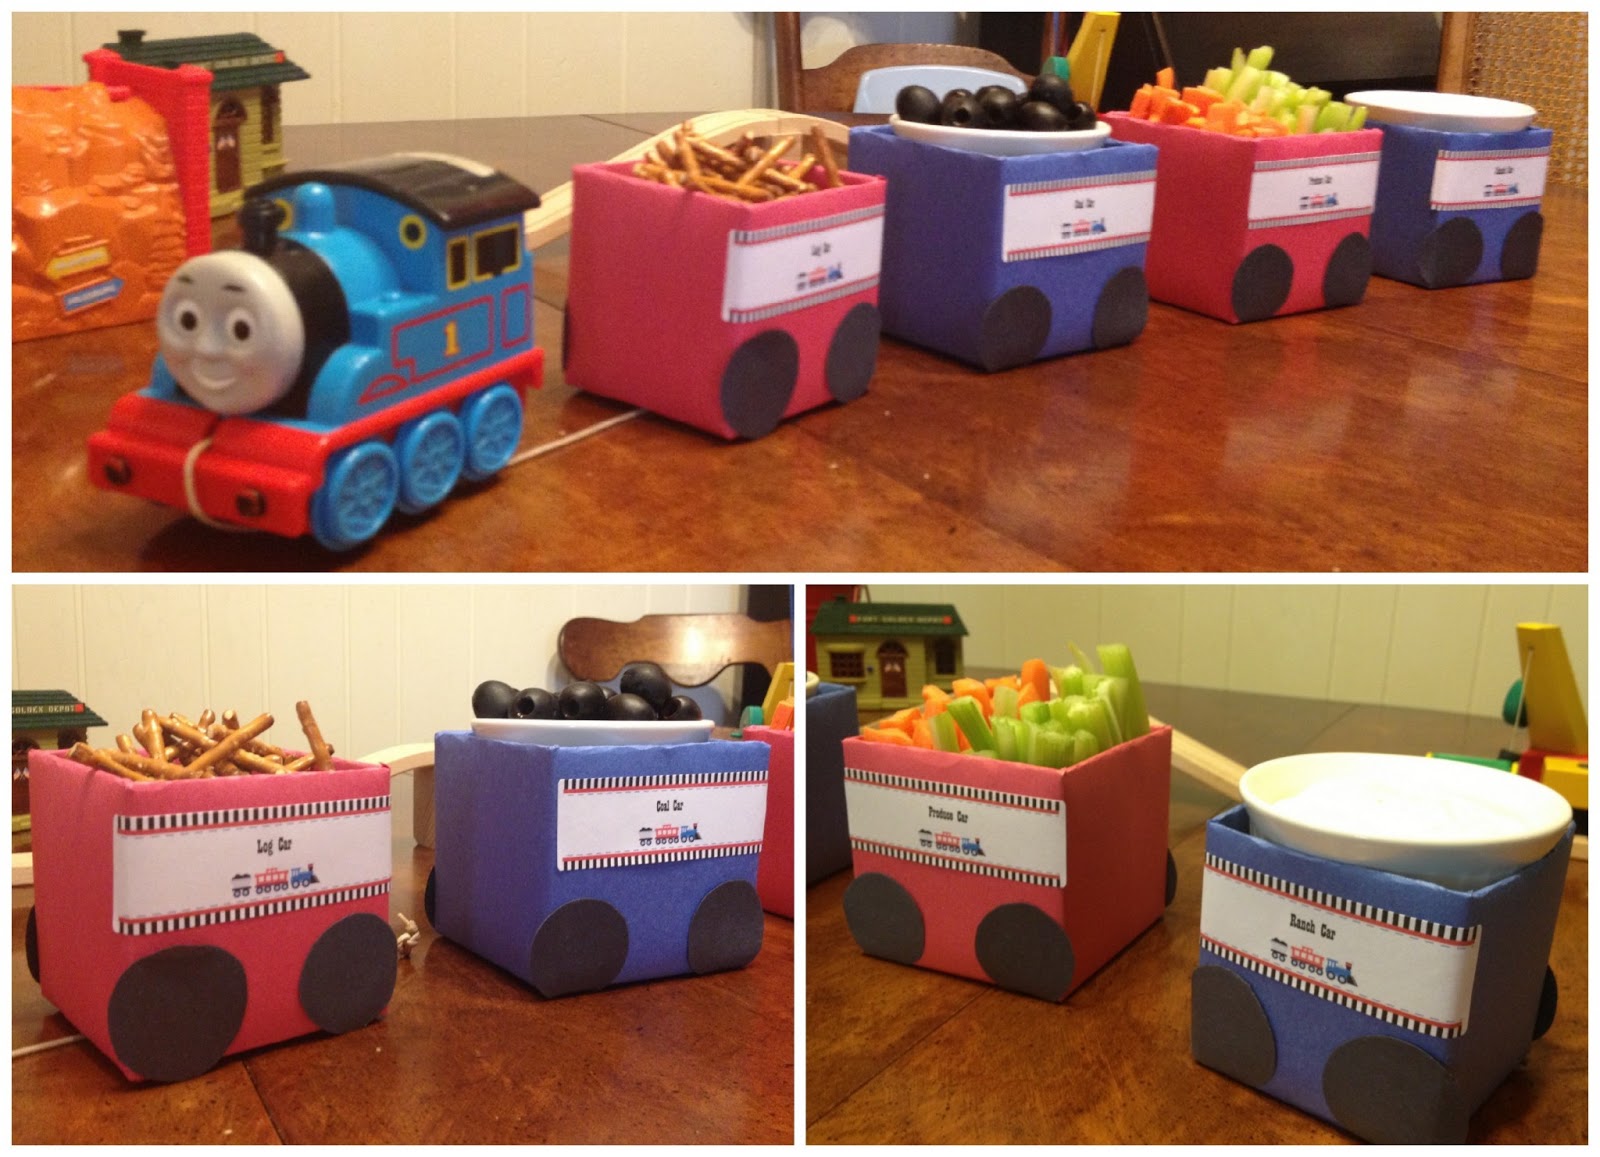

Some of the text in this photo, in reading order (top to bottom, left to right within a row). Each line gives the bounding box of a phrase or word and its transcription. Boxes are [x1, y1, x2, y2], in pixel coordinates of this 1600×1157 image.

[443, 320, 460, 357] 1
[48, 704, 75, 714] DEPOT
[656, 799, 684, 812] Coal Car
[928, 805, 968, 823] Produce Car
[257, 836, 292, 856] Log Car
[1290, 913, 1336, 940] Ranch Car
